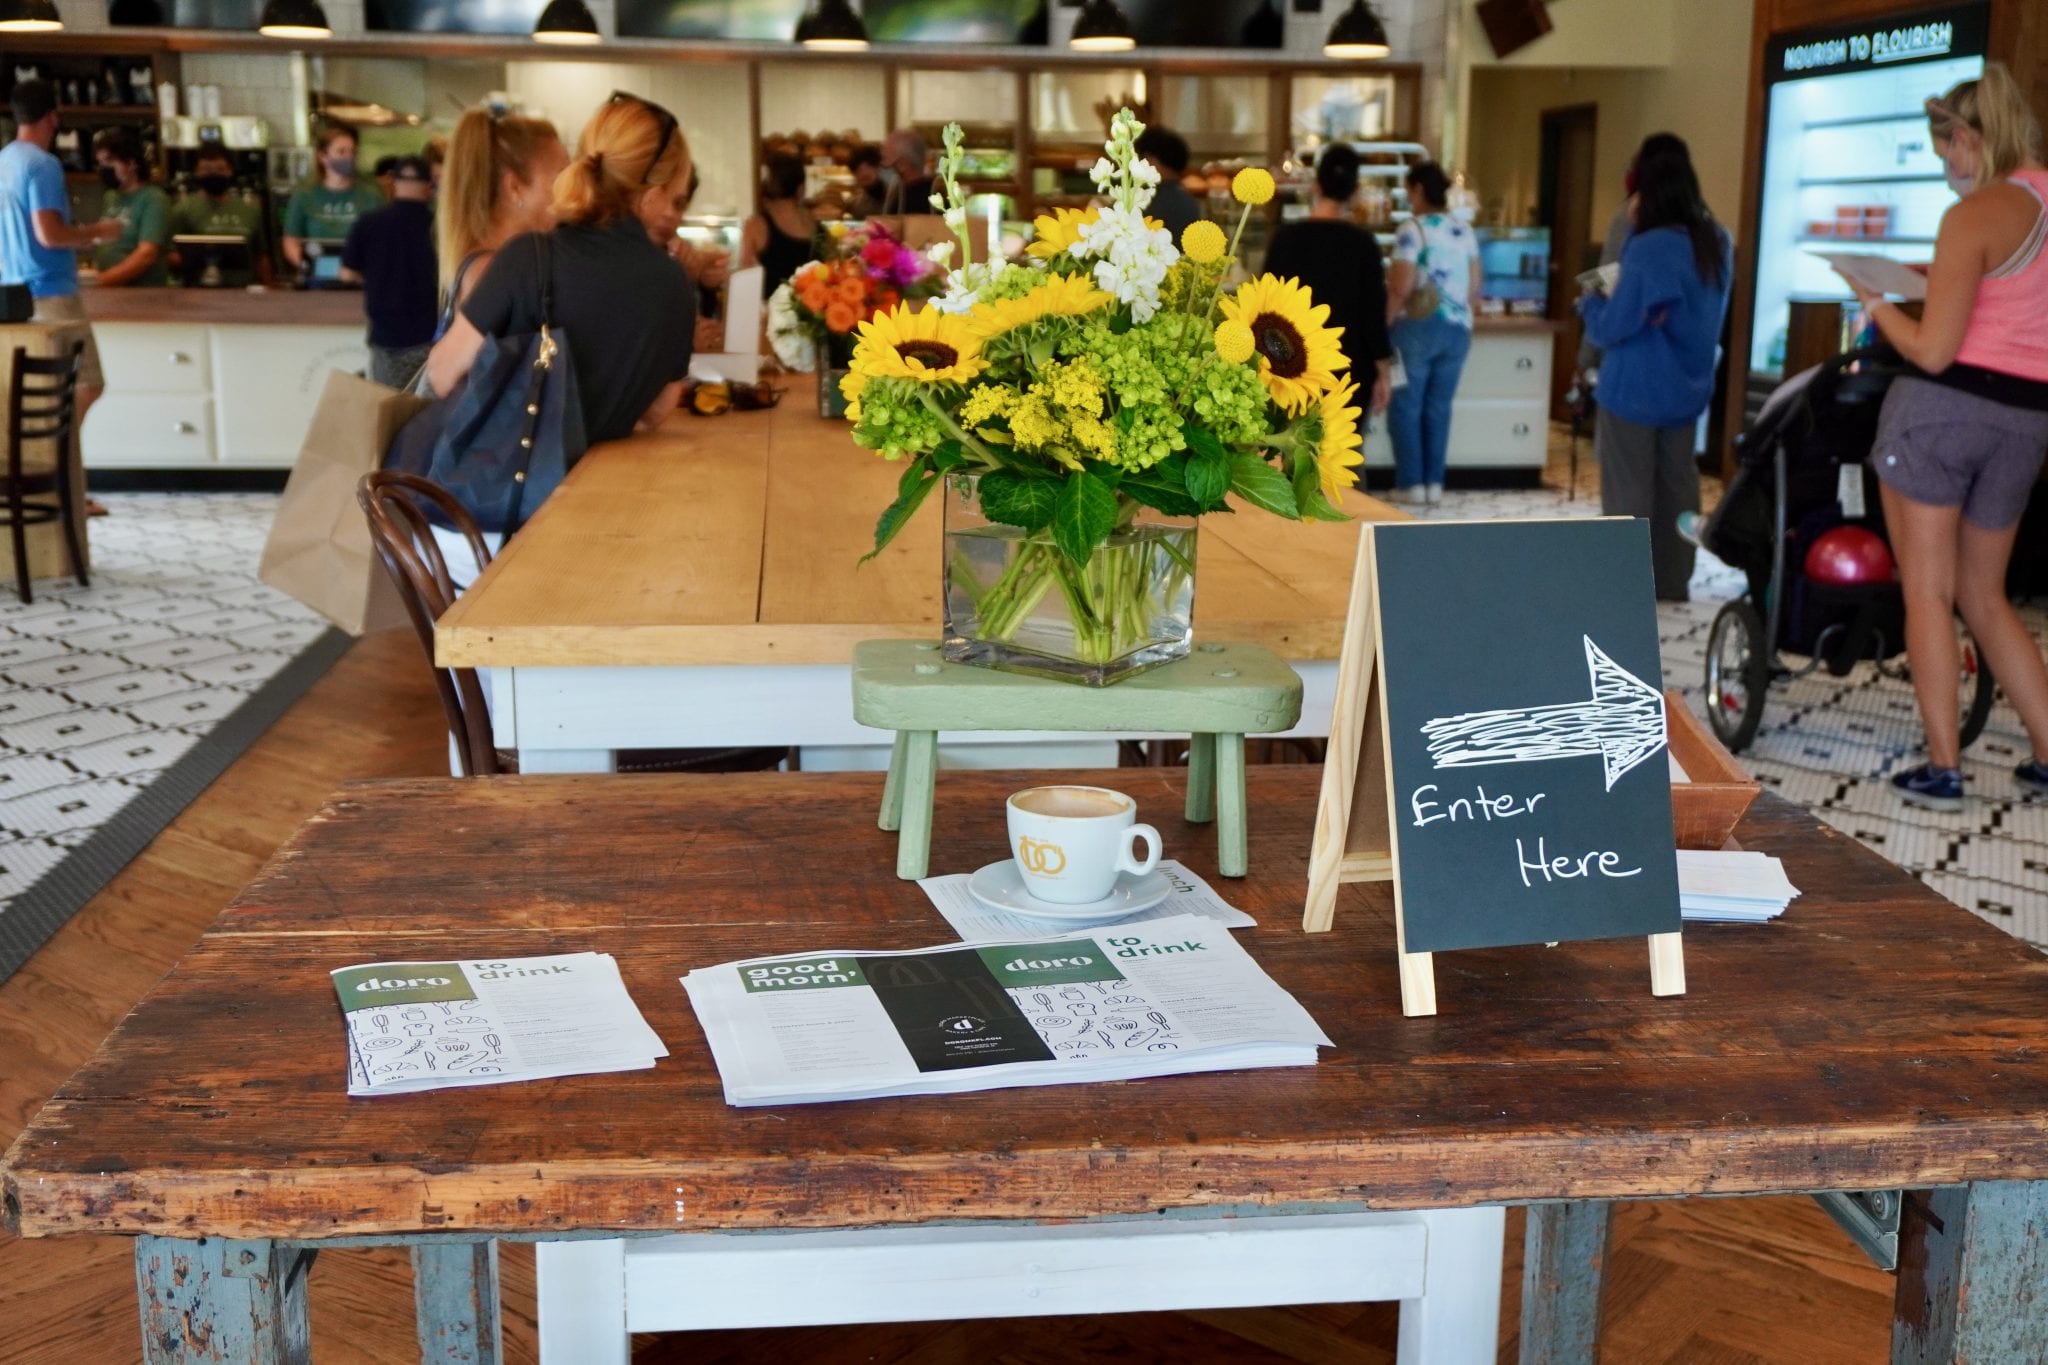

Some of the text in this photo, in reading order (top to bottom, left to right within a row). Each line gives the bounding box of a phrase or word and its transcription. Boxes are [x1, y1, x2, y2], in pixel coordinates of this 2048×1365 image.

[1783, 20, 1952, 71] NOURISH TO FLOURISH
[1412, 784, 1545, 826] Enter
[1516, 837, 1642, 887] Here
[1106, 937, 1141, 946] to
[1117, 941, 1208, 957] drink
[479, 965, 573, 979] drink
[747, 960, 839, 979] good
[1005, 957, 1093, 971] doro
[356, 977, 451, 992] doro
